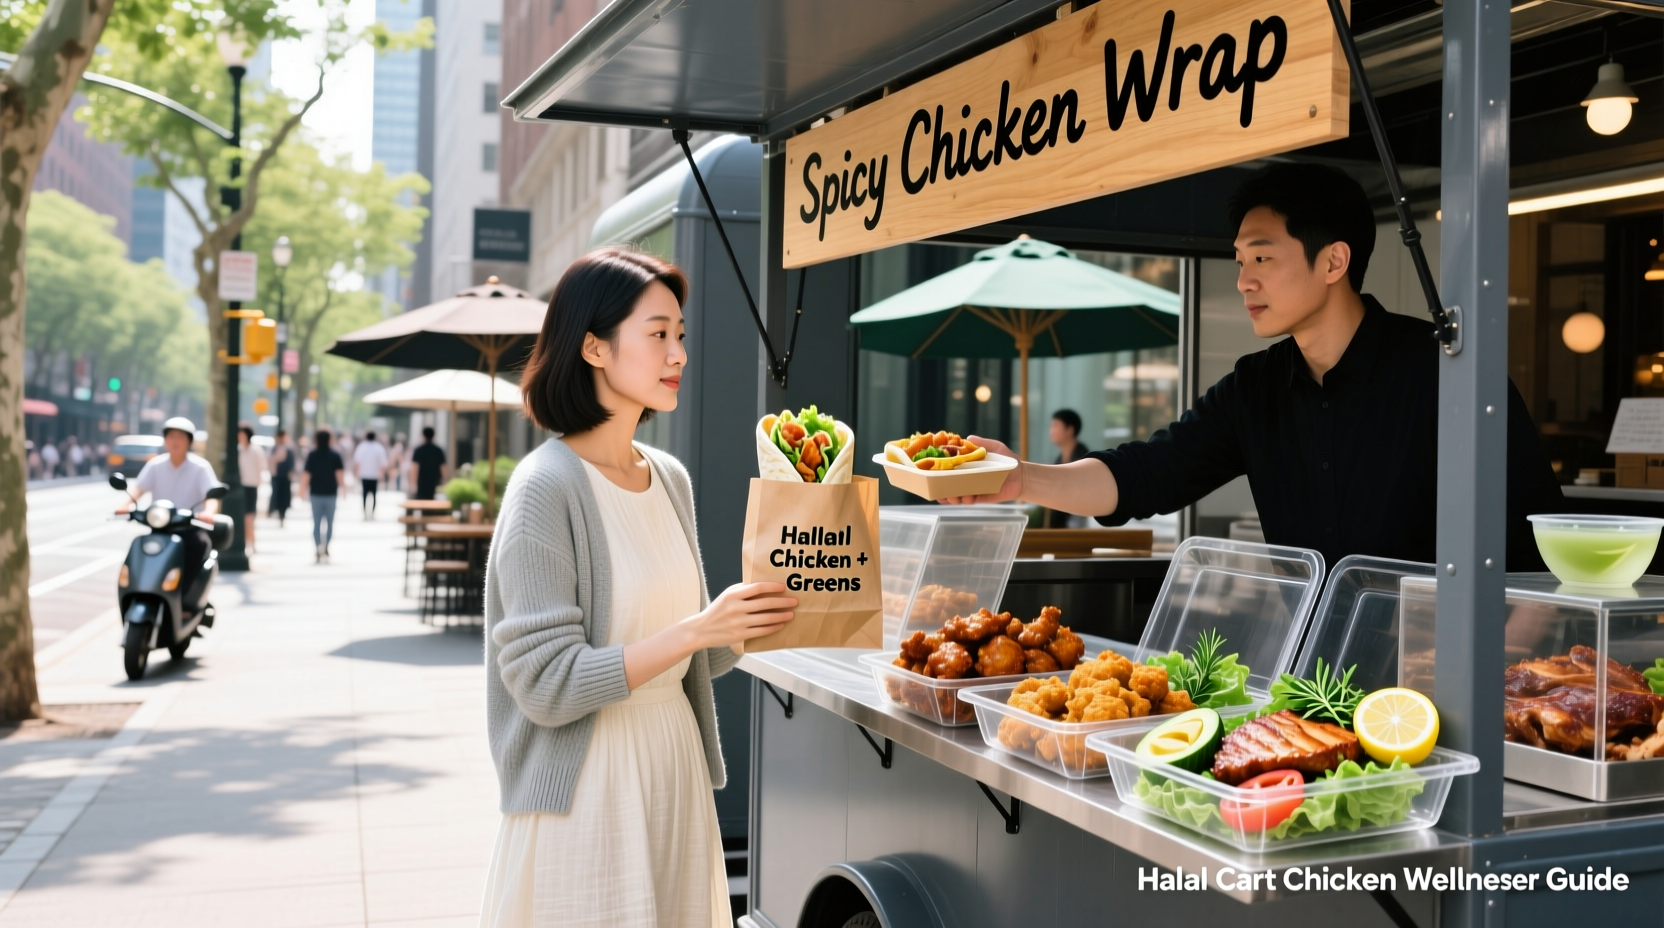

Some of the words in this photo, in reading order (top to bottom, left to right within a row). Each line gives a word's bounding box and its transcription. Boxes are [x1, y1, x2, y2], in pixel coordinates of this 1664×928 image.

[800, 150, 888, 242] Spicy
[900, 79, 1087, 195] Chicken
[1104, 9, 1288, 132] Wrap
[769, 548, 852, 569] Chicken
[856, 551, 869, 566] +
[786, 573, 861, 592] Greens
